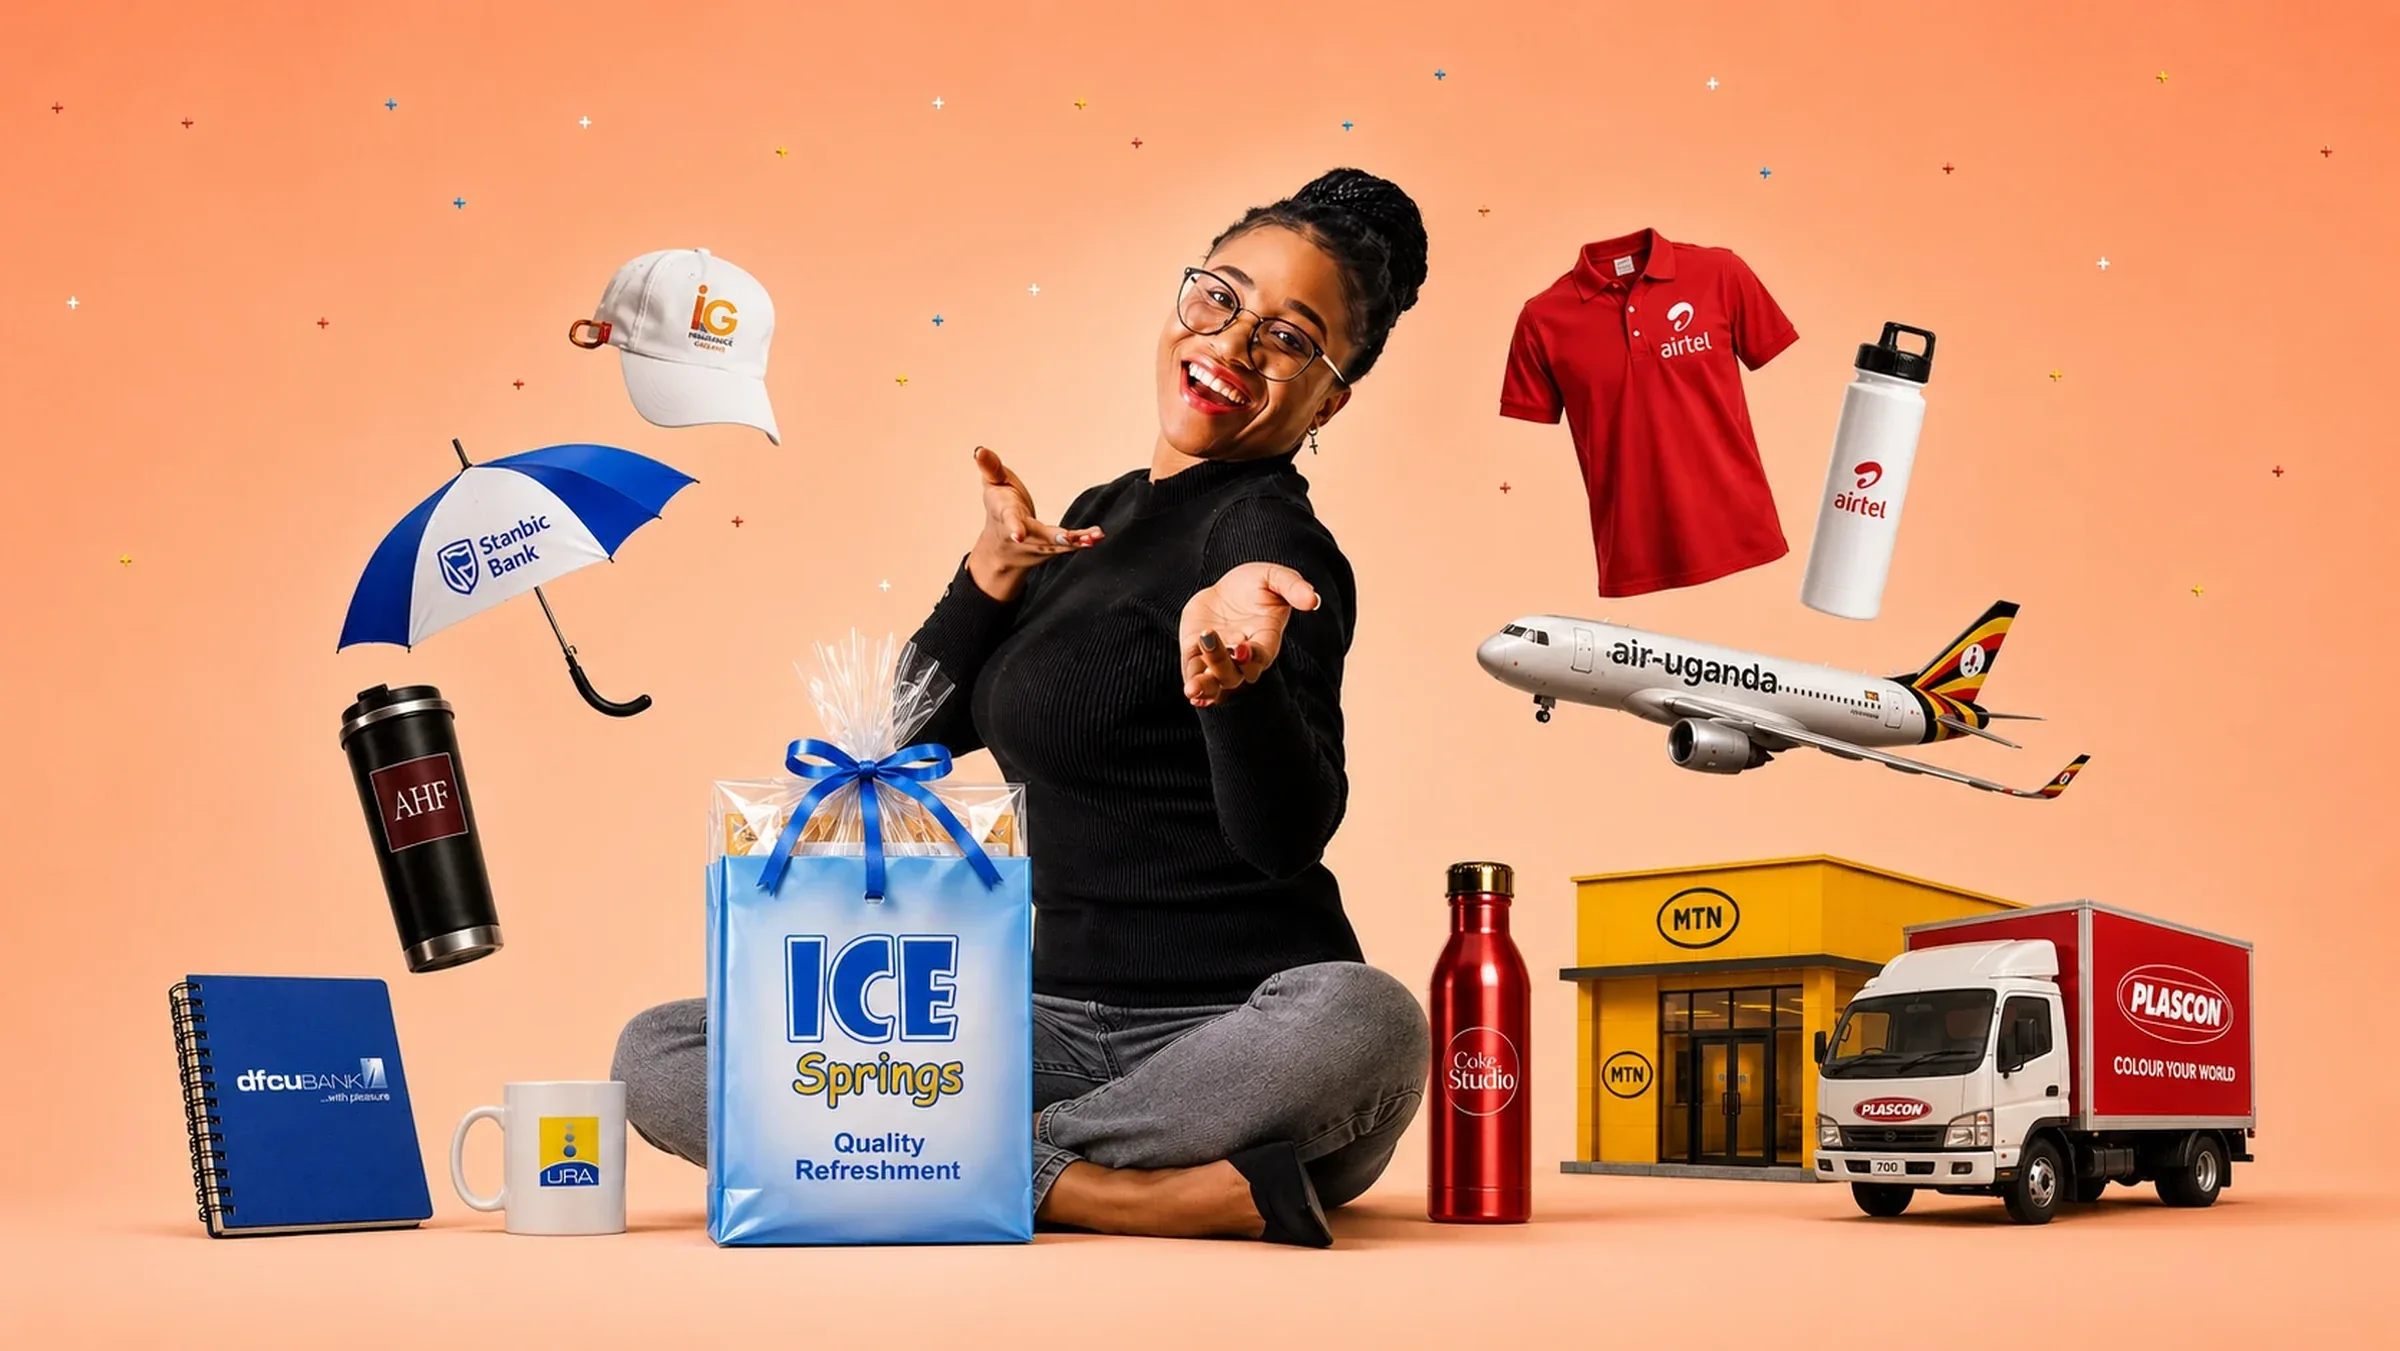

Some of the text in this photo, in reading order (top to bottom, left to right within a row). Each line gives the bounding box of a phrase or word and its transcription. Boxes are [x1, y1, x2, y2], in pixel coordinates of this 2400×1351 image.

[1661, 331, 1712, 358] airtel
[1834, 492, 1886, 518] airtel
[479, 515, 550, 555] Stanbic
[487, 544, 539, 578] Bank
[1611, 639, 1777, 694] air-uganda
[395, 780, 448, 821] AHF
[1673, 906, 1721, 931] MTN
[785, 934, 959, 1044] ICE
[2130, 982, 2222, 1027] PLASCON
[792, 1051, 963, 1109] Springs
[1448, 1066, 1514, 1090] Studio
[1611, 1067, 1644, 1083] MTN
[2114, 1056, 2236, 1082] COLOUR YOUR WORLD
[1861, 1103, 1924, 1116] PLASCON
[834, 1132, 925, 1157] Quality
[547, 1168, 594, 1184] URA
[796, 1159, 961, 1180] Refreshment
[1876, 1162, 1898, 1172] 700
